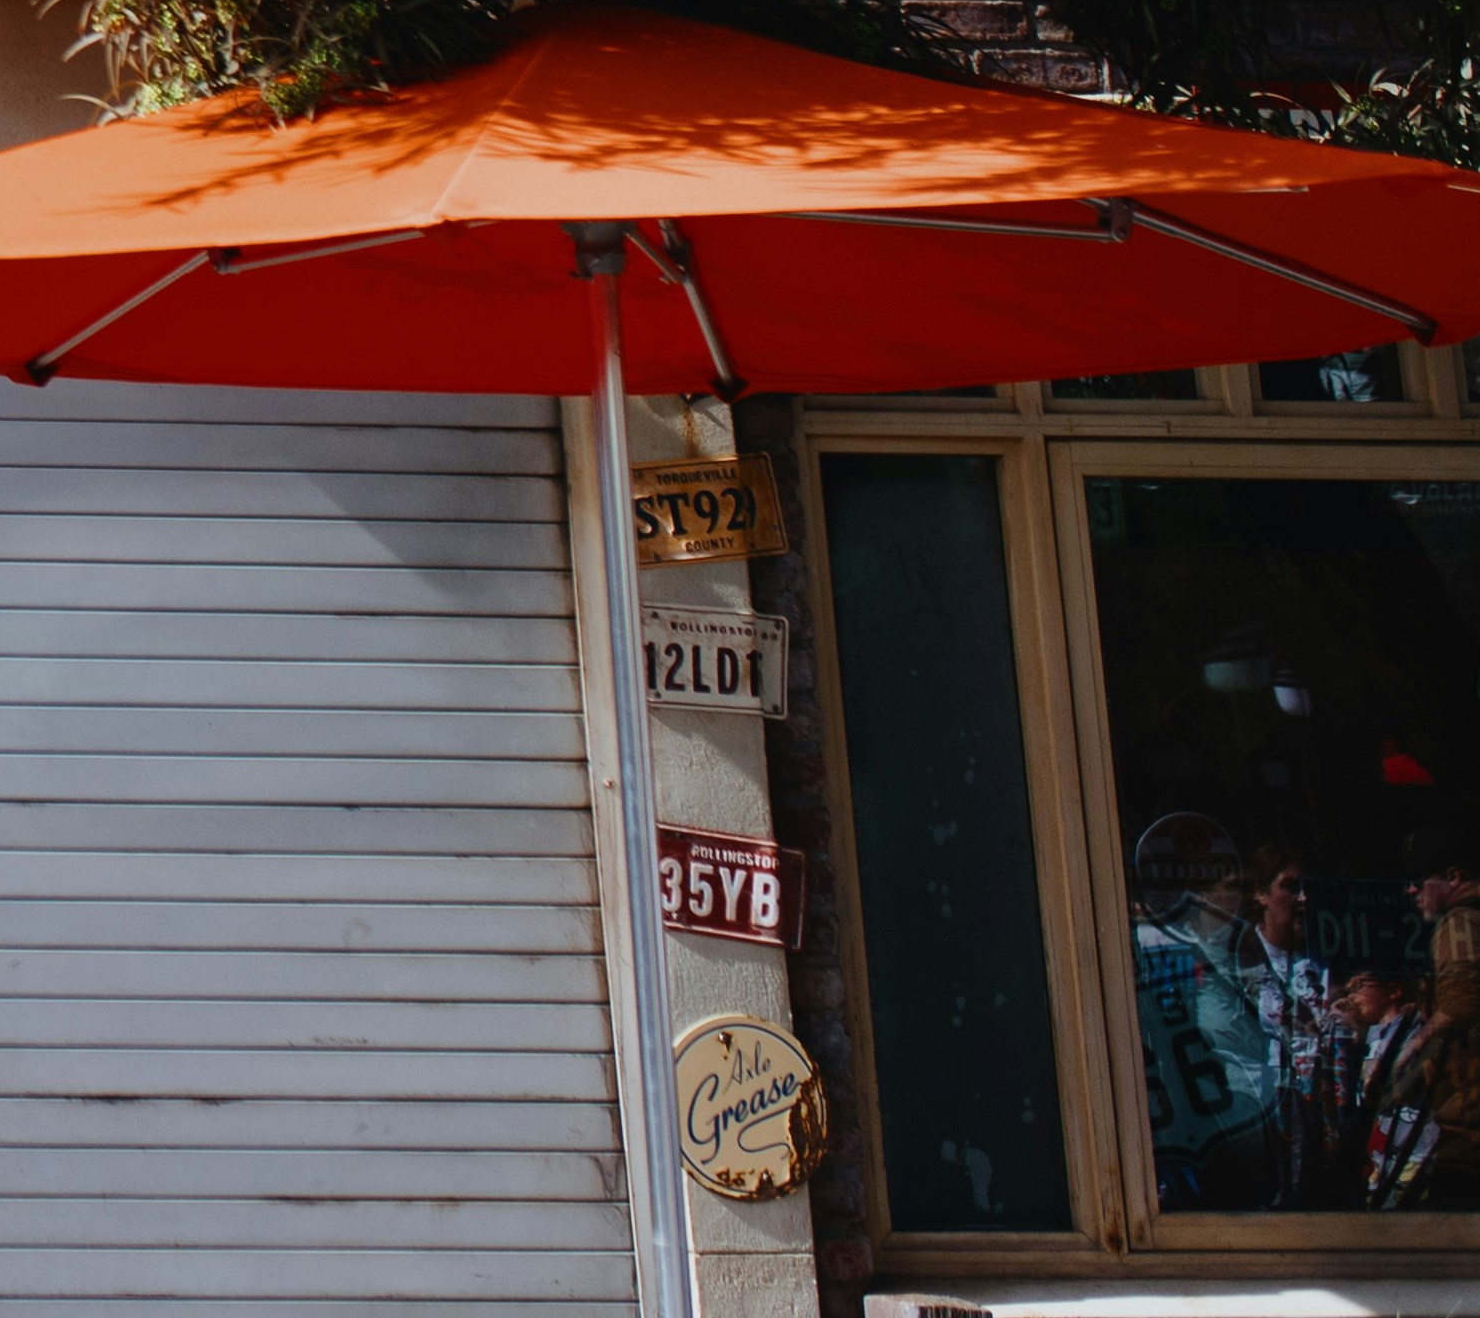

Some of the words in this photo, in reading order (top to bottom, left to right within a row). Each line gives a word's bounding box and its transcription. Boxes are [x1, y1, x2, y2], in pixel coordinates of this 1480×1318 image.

[655, 467, 738, 486] TORQUEVILLE
[685, 538, 735, 554] COUNTY
[724, 1040, 772, 1096] Axle
[686, 1071, 804, 1166] Grease
